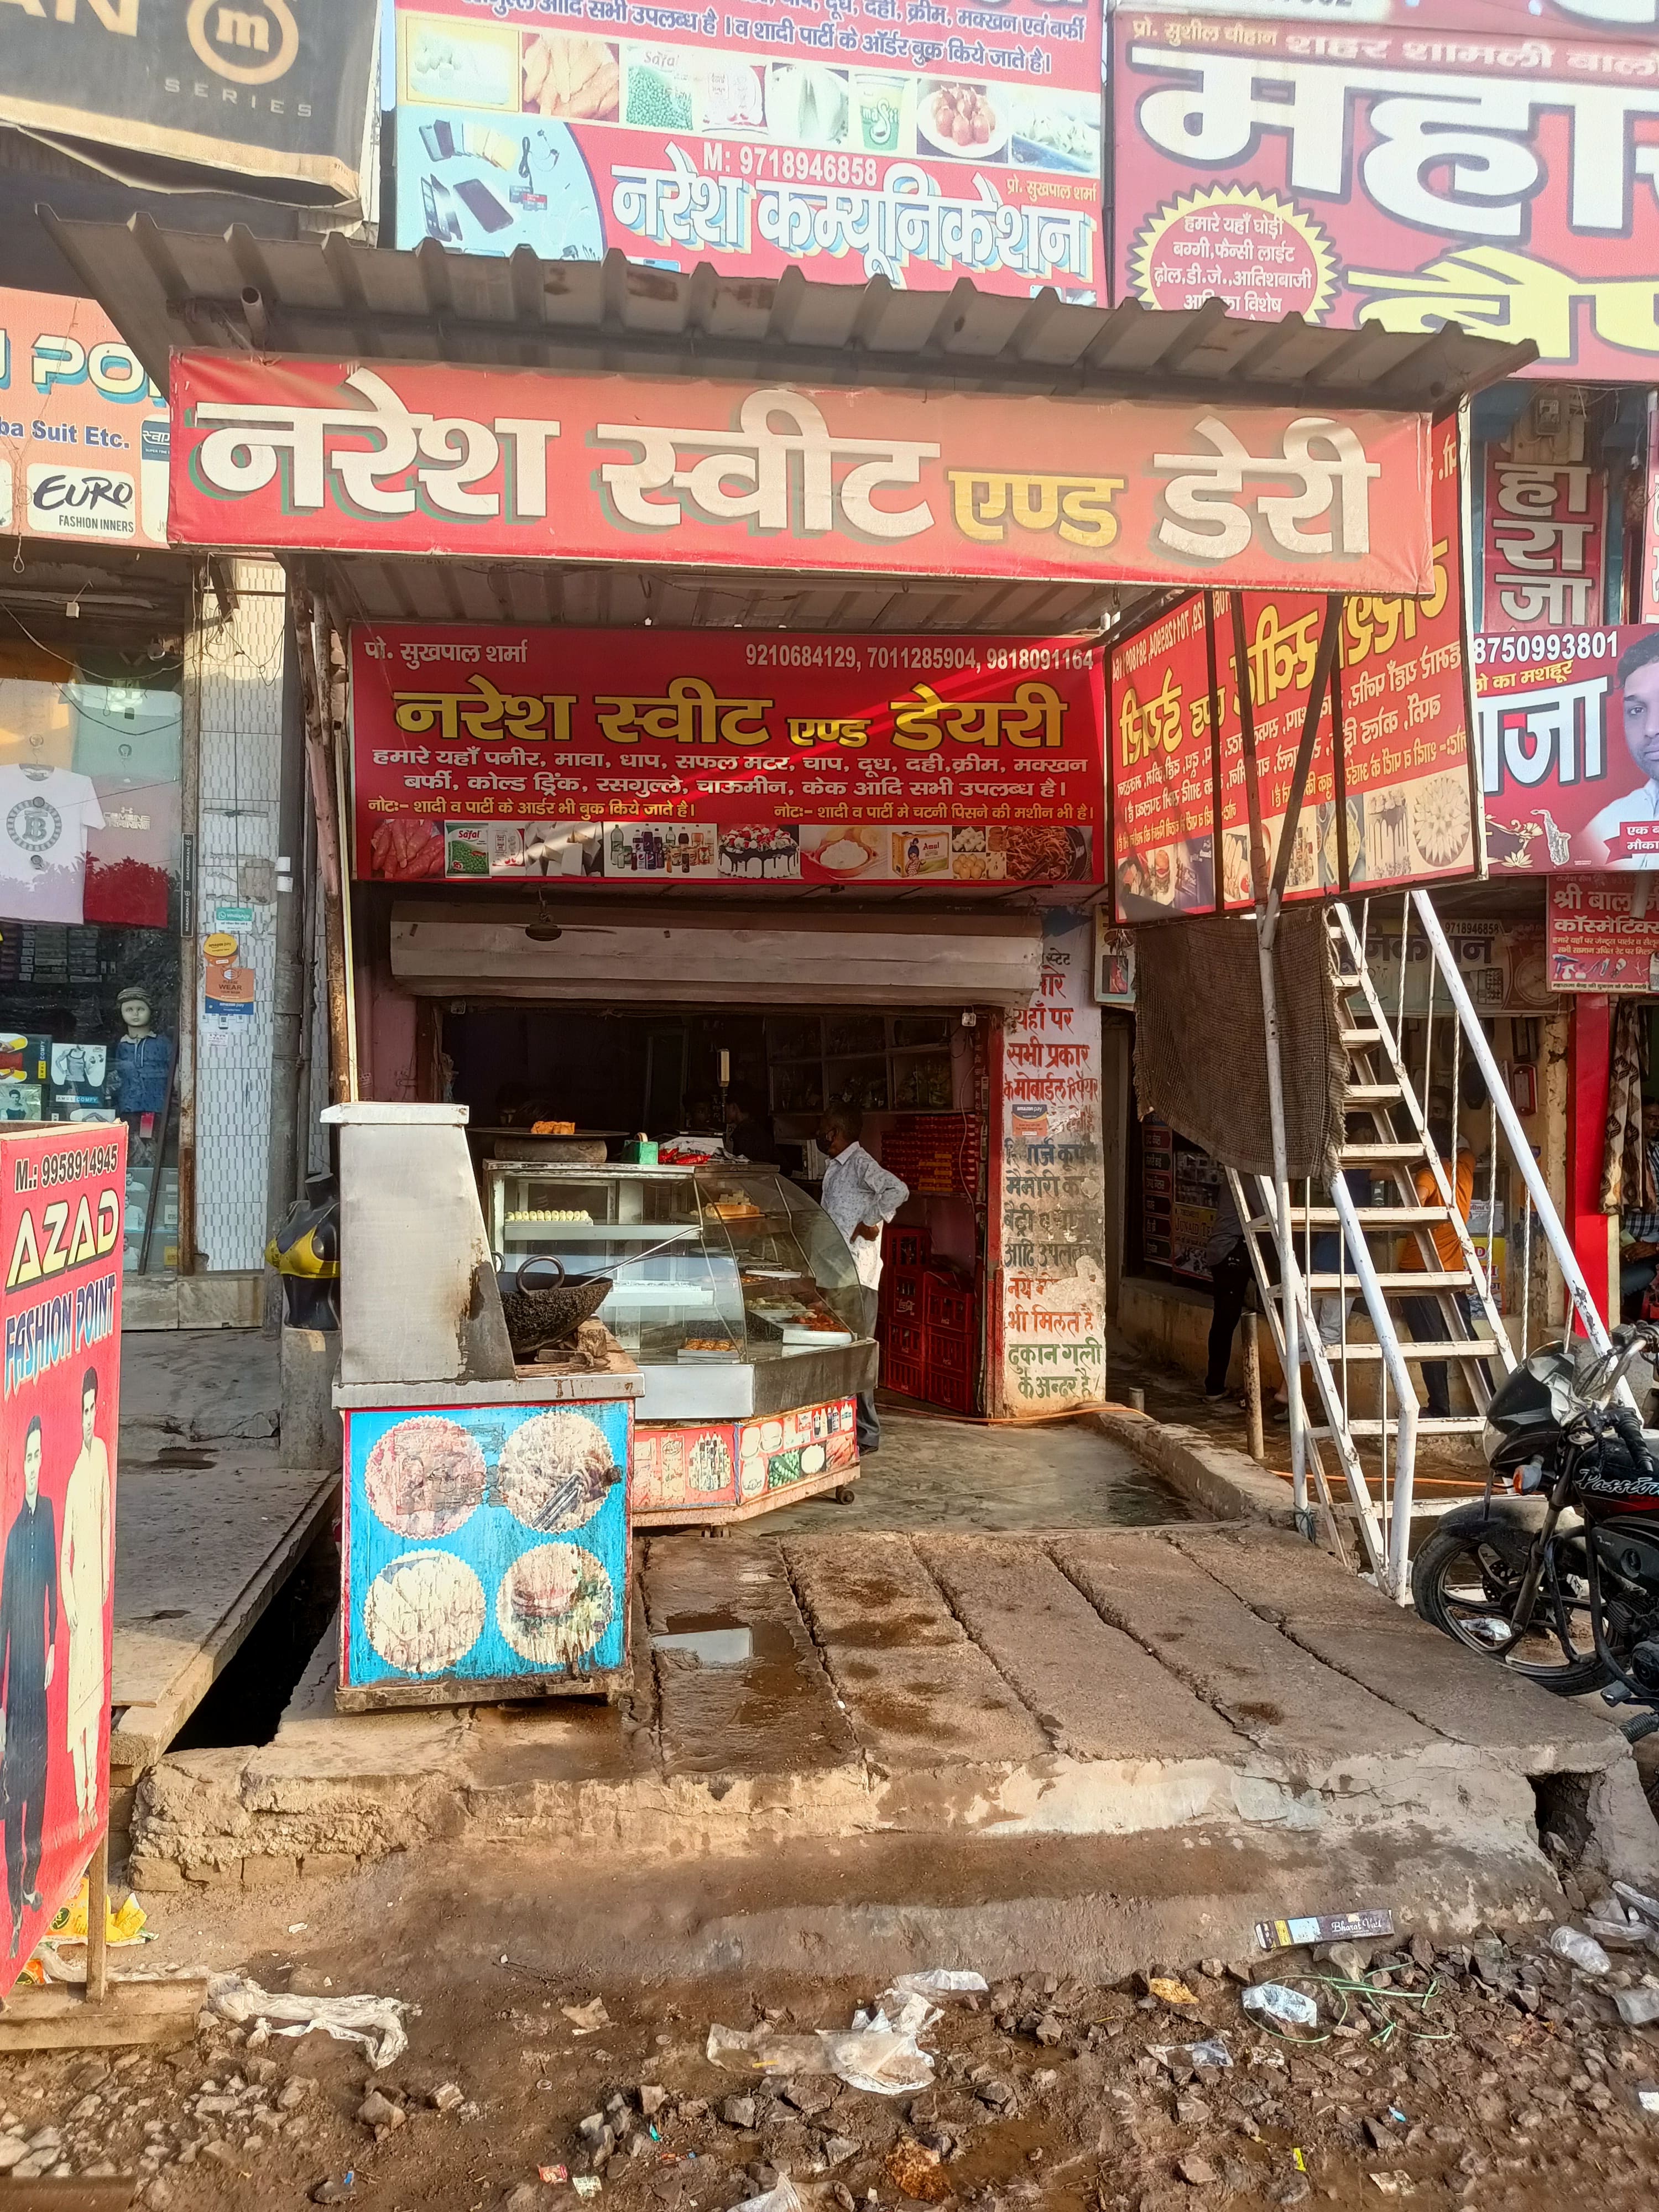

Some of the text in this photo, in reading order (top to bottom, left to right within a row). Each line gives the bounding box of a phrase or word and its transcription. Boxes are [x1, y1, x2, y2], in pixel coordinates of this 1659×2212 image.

[754, 17, 794, 43] शादी
[839, 26, 858, 49] के
[912, 40, 944, 65] बुक
[989, 46, 1026, 69] जाते
[165, 78, 312, 118] SERIES
[739, 145, 878, 187] 9718946858
[611, 140, 751, 248] नरेश
[1183, 211, 1221, 233] हमारे
[32, 419, 131, 450] Suit Etc.
[191, 367, 1383, 561] नरेश स्वीट एण्ड डेरी
[33, 474, 134, 511] EURO
[58, 514, 134, 534] FASHION INNERS
[399, 639, 528, 670] सुखपाल शर्मा
[745, 644, 1094, 674] 9210684129, 7011285904, 9818091164
[1474, 630, 1618, 664] 8750993801
[1493, 672, 1517, 690] का
[392, 674, 1069, 750] नरेश स्वीट एण्ड डेयरी
[372, 745, 431, 765] हमारे
[435, 746, 481, 767] यहाँ
[484, 747, 546, 768] पनीर,
[554, 753, 611, 769] मावा,
[675, 755, 740, 770] सफल
[743, 756, 795, 773] मटर,
[802, 757, 850, 773] चाप,
[858, 757, 898, 778] दूध,
[1013, 759, 1088, 773] मक्खन
[404, 771, 460, 791] बर्फी,
[467, 771, 528, 791] कोल्ड
[596, 775, 688, 799] रसगुल्ले,
[696, 775, 794, 796] चाऊमीन,
[801, 777, 848, 795] केक
[853, 777, 904, 796] आदि
[909, 778, 953, 797] सभी
[958, 782, 1034, 797] उपलब्ध
[413, 796, 446, 813] शादी
[450, 801, 461, 813] व
[465, 797, 494, 815] पार्टी
[498, 798, 514, 815] के
[517, 797, 555, 816] आर्डर
[558, 797, 576, 815] भी
[579, 802, 605, 821] बुक
[609, 799, 639, 816] किये
[643, 800, 674, 817] जाते
[817, 801, 849, 819] शादी
[852, 806, 863, 819] व
[867, 802, 894, 819] पार्टी
[912, 802, 948, 820] चटनी
[951, 802, 989, 820] पिसने
[992, 802, 1010, 820] की
[1014, 803, 1053, 820] मशीन
[1056, 803, 1073, 820] भी
[922, 842, 940, 852] Amul
[1553, 882, 1583, 910] श्री
[41, 1144, 119, 1186] 9958914945
[5, 1189, 120, 1295] AZAD
[4, 1273, 116, 1400] FASHION POINT
